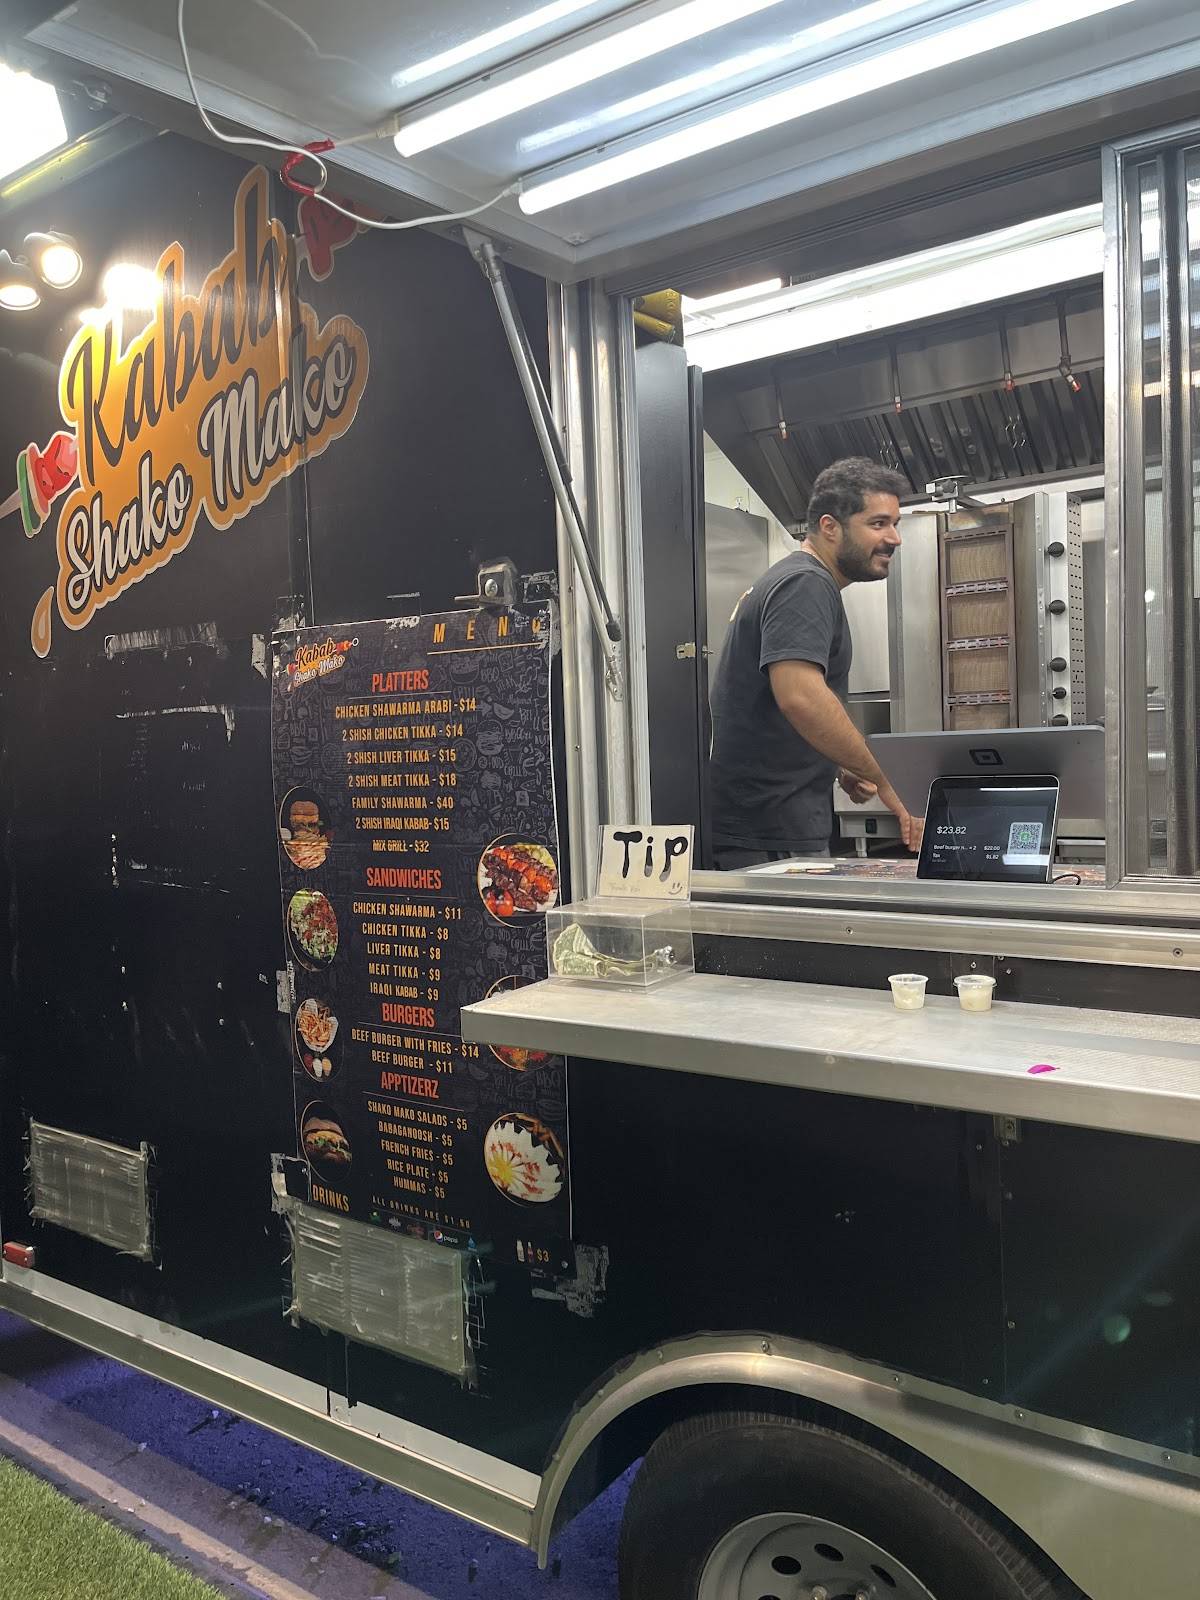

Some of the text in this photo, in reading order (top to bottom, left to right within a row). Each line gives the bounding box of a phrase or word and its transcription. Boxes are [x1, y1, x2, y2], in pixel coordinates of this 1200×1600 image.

[67, 183, 284, 487] Kabab
[66, 333, 355, 612] Shako Mako
[296, 638, 335, 669] Kabab
[319, 655, 345, 675] Mako
[372, 670, 429, 692] PLATTERS
[336, 704, 370, 719] CHICKEN
[372, 702, 421, 717] SHAWARMA
[424, 700, 452, 715] ARABI
[460, 698, 476, 712] $14
[342, 729, 347, 741] 2
[349, 728, 372, 741] SHISH
[374, 726, 408, 741] CHICKEN
[411, 725, 436, 739] TIKKA
[446, 724, 463, 738] $14
[347, 752, 352, 764] 2
[354, 751, 378, 764] SHISH
[379, 750, 402, 764] LIVER
[404, 749, 430, 763] TIKKA
[439, 748, 456, 762] $15
[348, 776, 353, 787] 2
[356, 775, 378, 788] SHISH
[381, 774, 402, 787] MEAT
[405, 774, 430, 787] TIKKA
[439, 773, 456, 786] $18
[352, 798, 378, 810] FAMILY
[382, 797, 427, 810] SHAWARMA
[436, 796, 454, 810] $40
[356, 817, 360, 828] 2
[362, 817, 382, 829] SHISH
[384, 817, 402, 831] IRAQI
[434, 818, 449, 831] $15
[936, 826, 966, 835] $23.82
[372, 840, 386, 852] MIX
[388, 840, 408, 852] GRILL
[414, 840, 430, 853] $32
[366, 867, 442, 890] SANDWICHES
[353, 902, 388, 916] CHICKEN
[389, 903, 436, 918] SHAWARMA
[444, 906, 462, 920] $11
[362, 922, 398, 937] CHICKEN
[400, 924, 427, 939] TIKKA
[437, 927, 448, 941] $8
[367, 942, 391, 956] LIVER
[393, 944, 419, 958] TIKKA
[430, 946, 440, 960] $8
[368, 962, 391, 976] MEAT
[393, 964, 418, 980] TIKKA
[429, 967, 440, 982] $9
[370, 982, 392, 997] IRAQI
[395, 984, 418, 999] KABAB
[428, 987, 438, 1001] $9
[382, 1003, 435, 1028] BURGERS
[352, 1028, 370, 1042] BEEF
[372, 1032, 402, 1048] BURGER
[404, 1036, 426, 1051] WITH
[428, 1040, 452, 1055] FRIES
[462, 1044, 480, 1058] $14
[372, 1050, 390, 1064] BEEF
[392, 1052, 424, 1070] BURGER
[436, 1060, 452, 1074] $11
[381, 1071, 440, 1099] APPTIZERZ
[368, 1100, 392, 1116] SHAKO
[394, 1104, 415, 1121] MAKO
[417, 1109, 448, 1127] SALADS
[456, 1116, 468, 1131] $5
[378, 1121, 433, 1144] BABAGANOOSH
[442, 1133, 452, 1148] $5
[381, 1140, 410, 1156] FRENCH
[412, 1146, 434, 1162] FRIES
[442, 1152, 453, 1166] $5
[387, 1158, 404, 1173] RICE
[406, 1162, 429, 1180] PLATE
[438, 1169, 448, 1184] $5
[312, 1184, 350, 1212] DRINKS
[393, 1176, 426, 1195] HUMMAS
[434, 1185, 445, 1199] $5
[372, 1196, 386, 1207] ALL
[390, 1201, 419, 1216] DRINKS
[424, 1209, 440, 1220] ARE
[536, 1248, 549, 1262] $3
